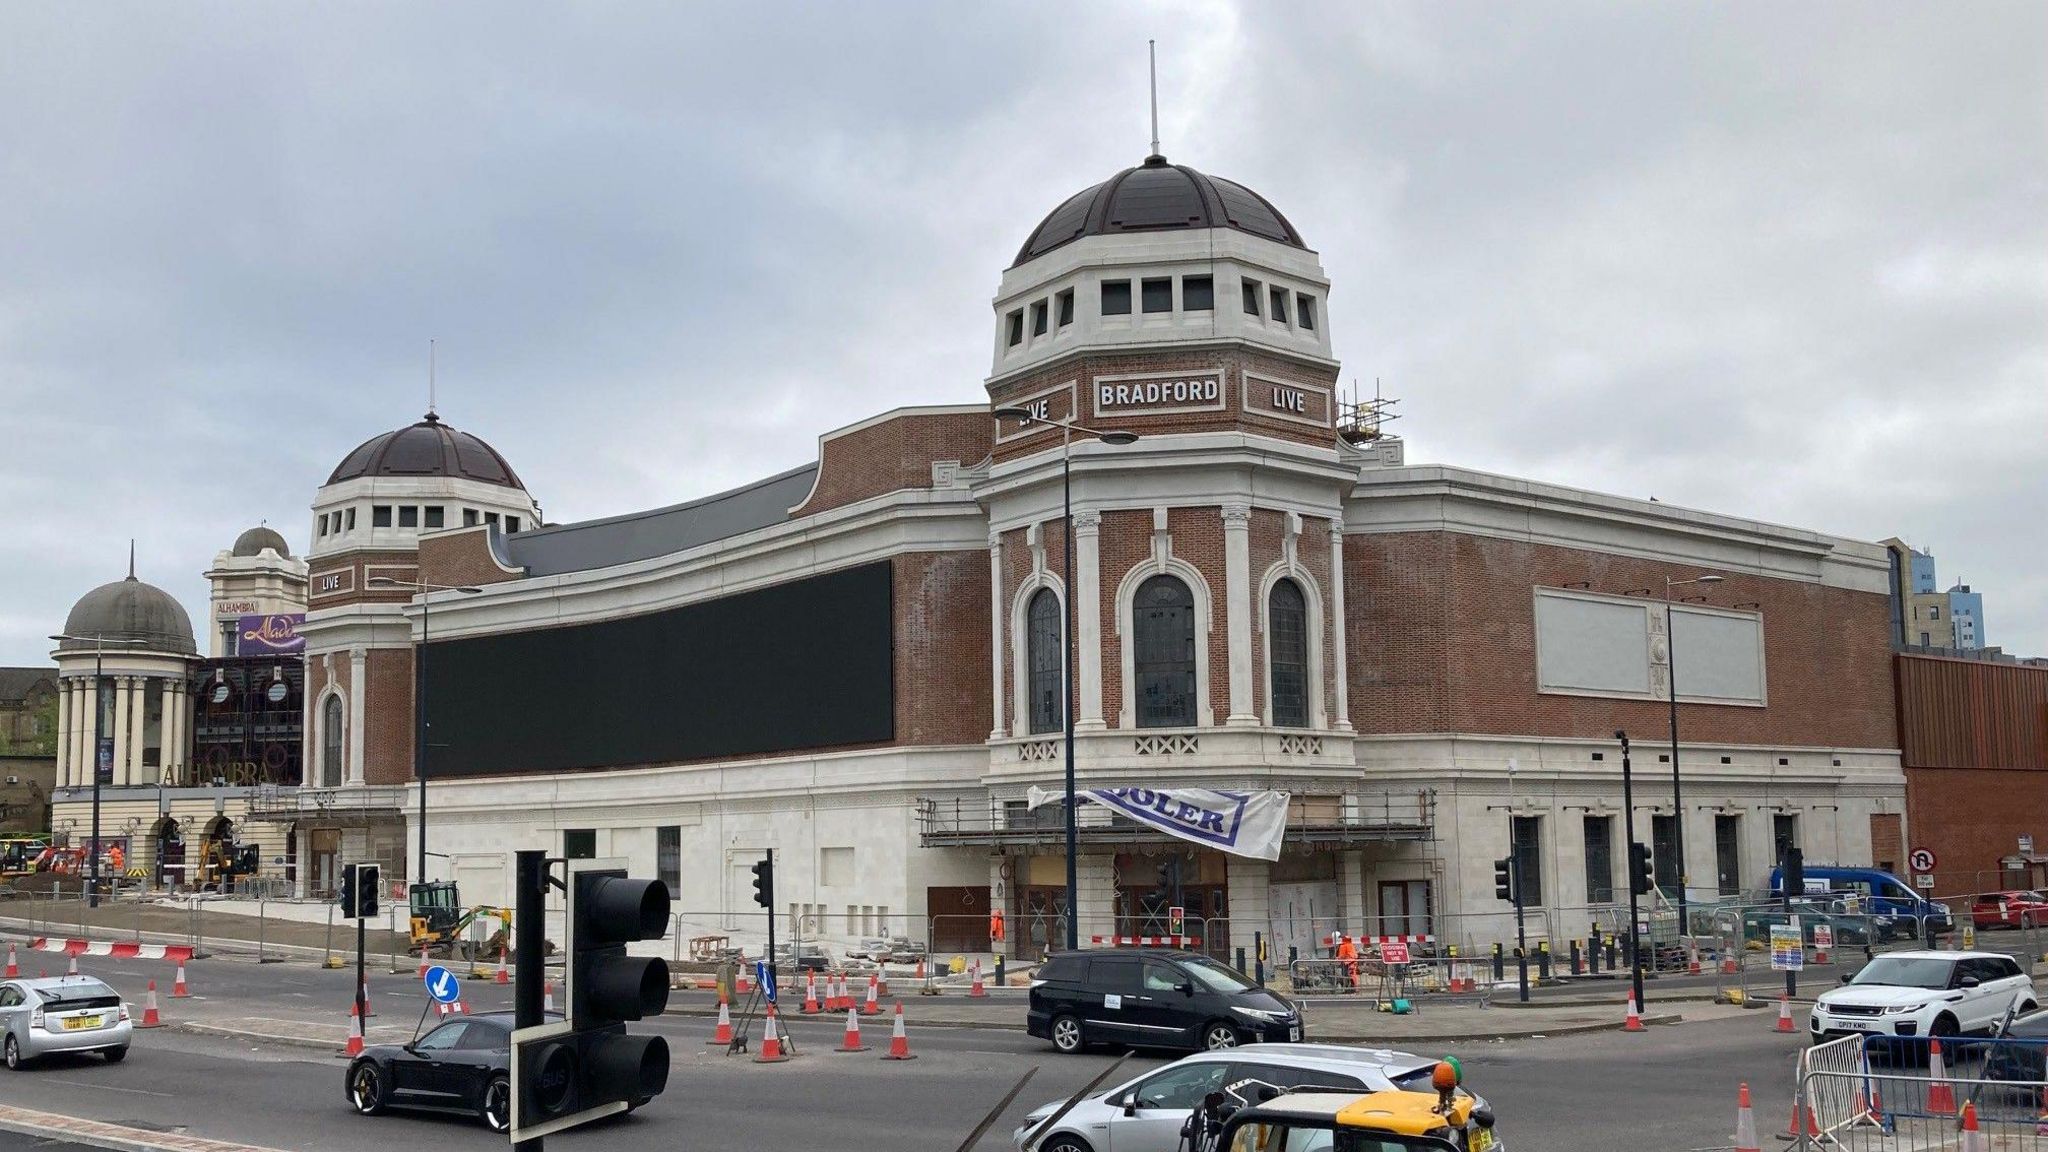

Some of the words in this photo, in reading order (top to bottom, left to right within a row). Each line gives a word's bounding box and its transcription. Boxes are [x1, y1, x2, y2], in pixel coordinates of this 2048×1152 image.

[1101, 380, 1218, 406] BRADFORD
[1273, 387, 1305, 412] LIVE
[322, 575, 340, 590] LIVE
[217, 603, 255, 613] ALHAMBRA
[163, 762, 271, 785] ALHAMBRA
